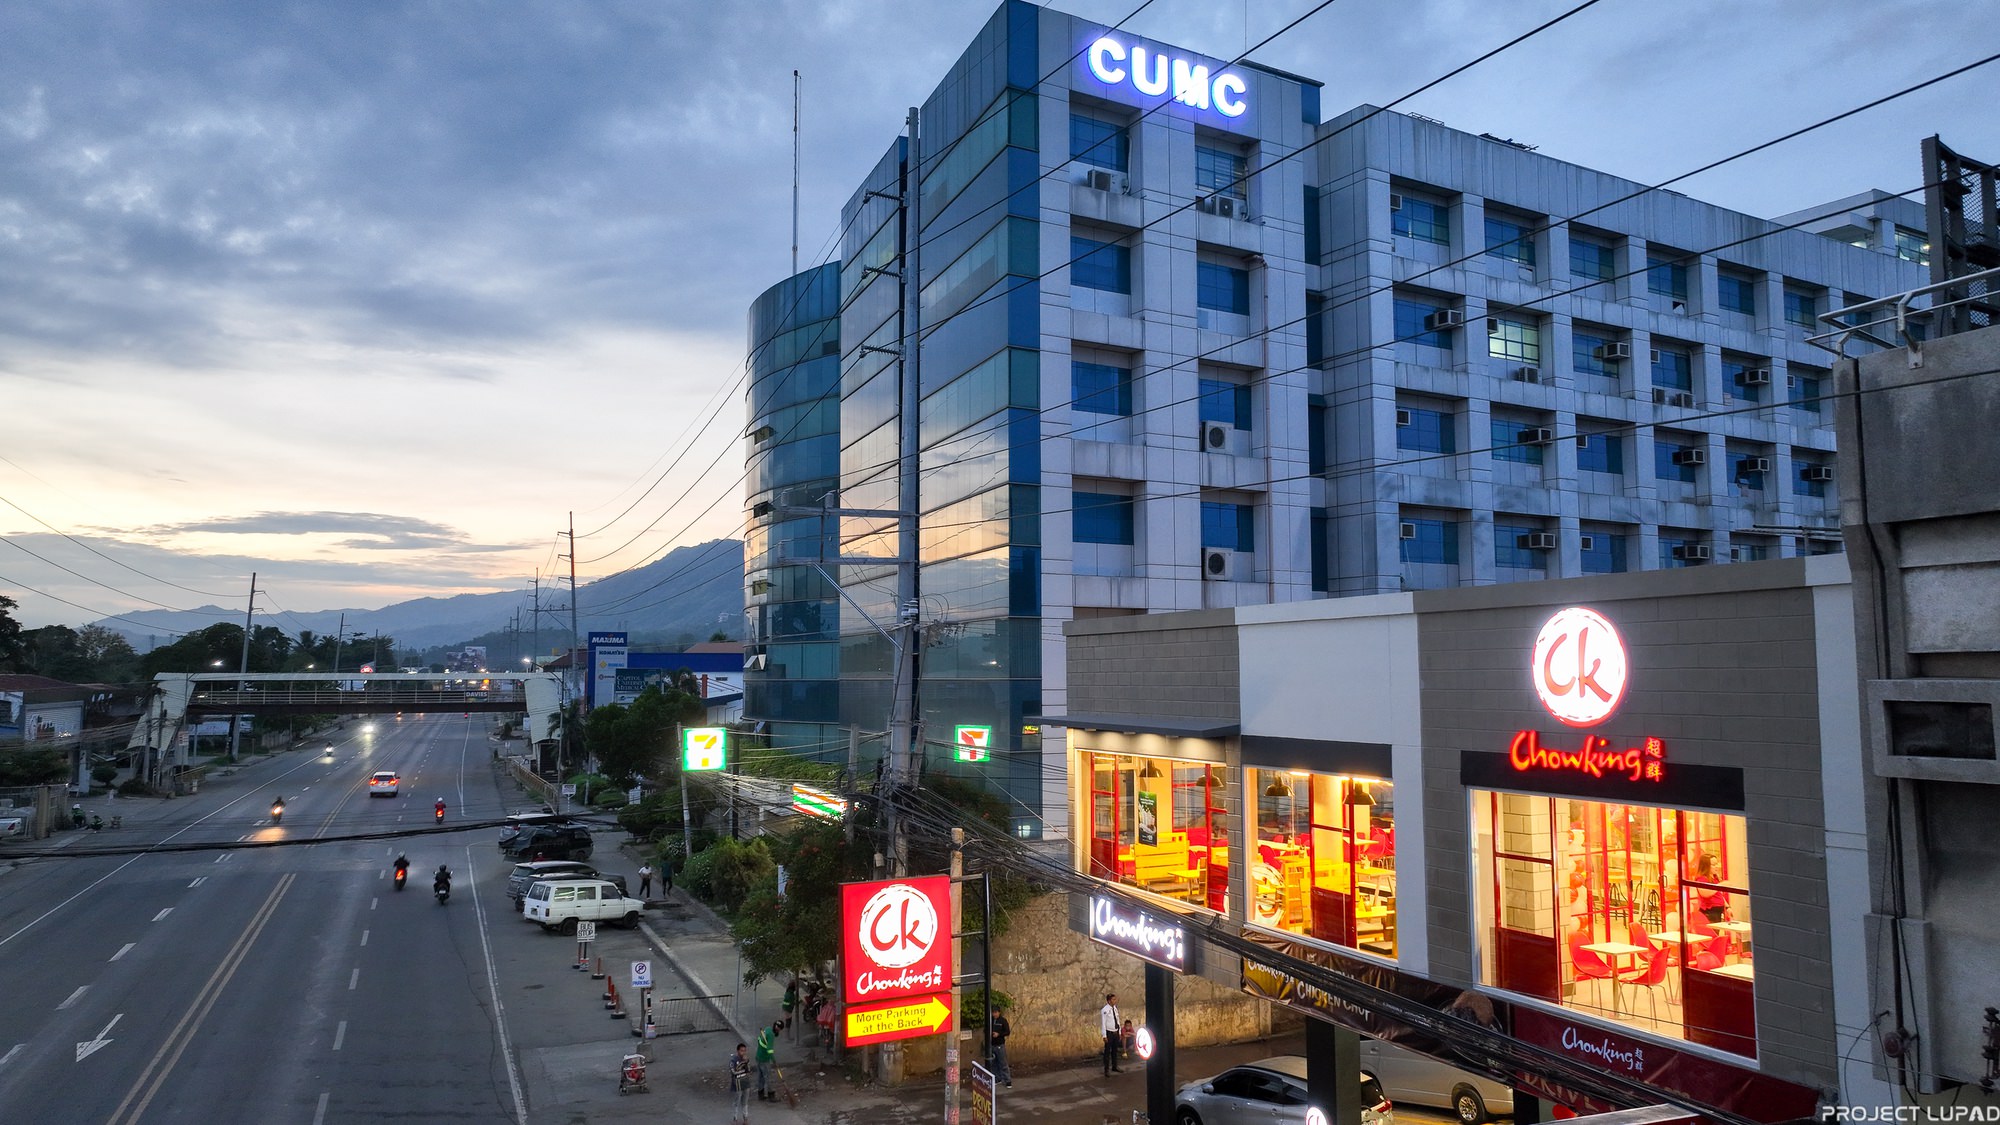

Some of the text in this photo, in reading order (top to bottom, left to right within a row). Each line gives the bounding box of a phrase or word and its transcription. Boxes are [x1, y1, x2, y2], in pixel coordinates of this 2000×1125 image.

[1088, 38, 1248, 118] CUMC
[591, 636, 625, 644] MAXIMA
[1544, 627, 1613, 703] Ck
[1510, 730, 1641, 781] Chowking
[870, 898, 928, 951] Ck
[856, 968, 934, 995] Chowking
[856, 1006, 926, 1023] More Parking
[862, 1017, 923, 1033] at the Back
[1562, 1027, 1633, 1070] Chowking
[973, 1090, 991, 1117] DRIVE
